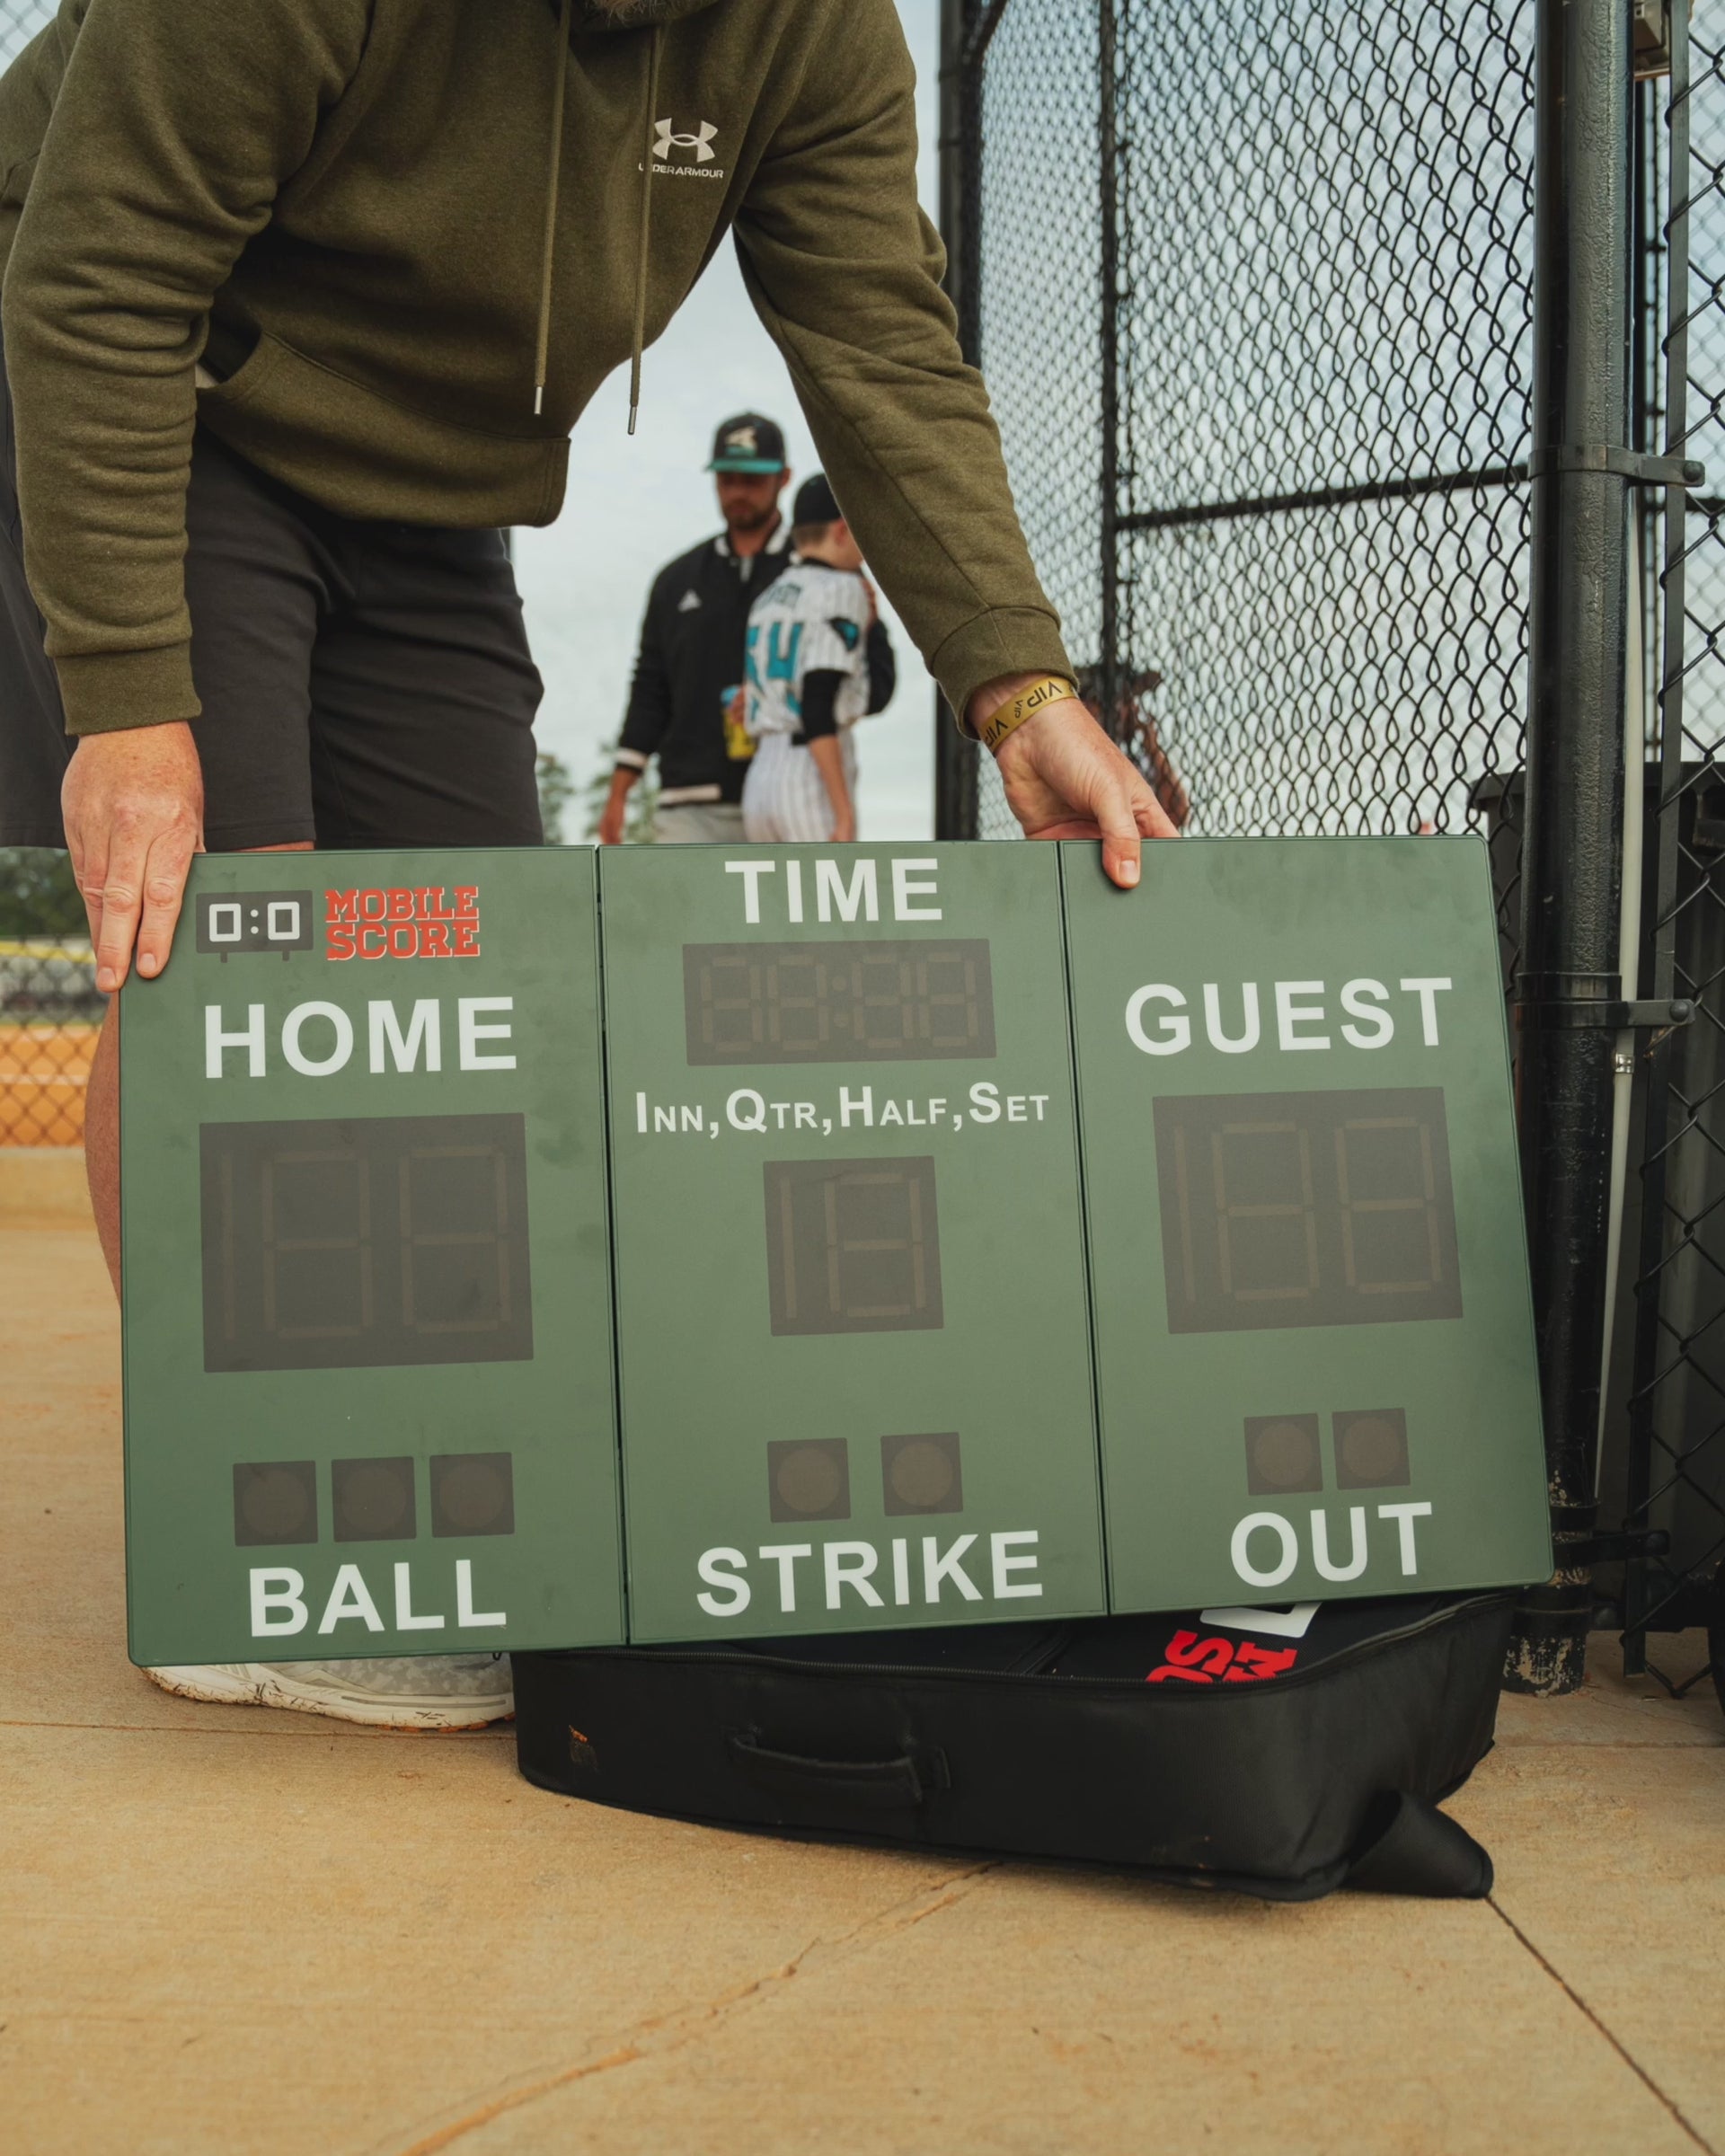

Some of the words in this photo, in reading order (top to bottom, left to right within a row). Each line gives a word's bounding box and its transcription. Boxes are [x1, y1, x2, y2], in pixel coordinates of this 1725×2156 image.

[638, 162, 674, 175] UDER
[675, 165, 724, 179] ARMOUR
[1013, 700, 1024, 719] VIP
[1026, 680, 1063, 708] VIP
[324, 886, 479, 923] MOBILE
[725, 858, 942, 924] TIME
[325, 920, 481, 960] SCORE
[205, 996, 517, 1079] HOME
[1125, 976, 1453, 1056] GUEST
[696, 1530, 1043, 1617] STRIKE
[1231, 1501, 1433, 1587] OUT
[250, 1560, 507, 1638] BALL
